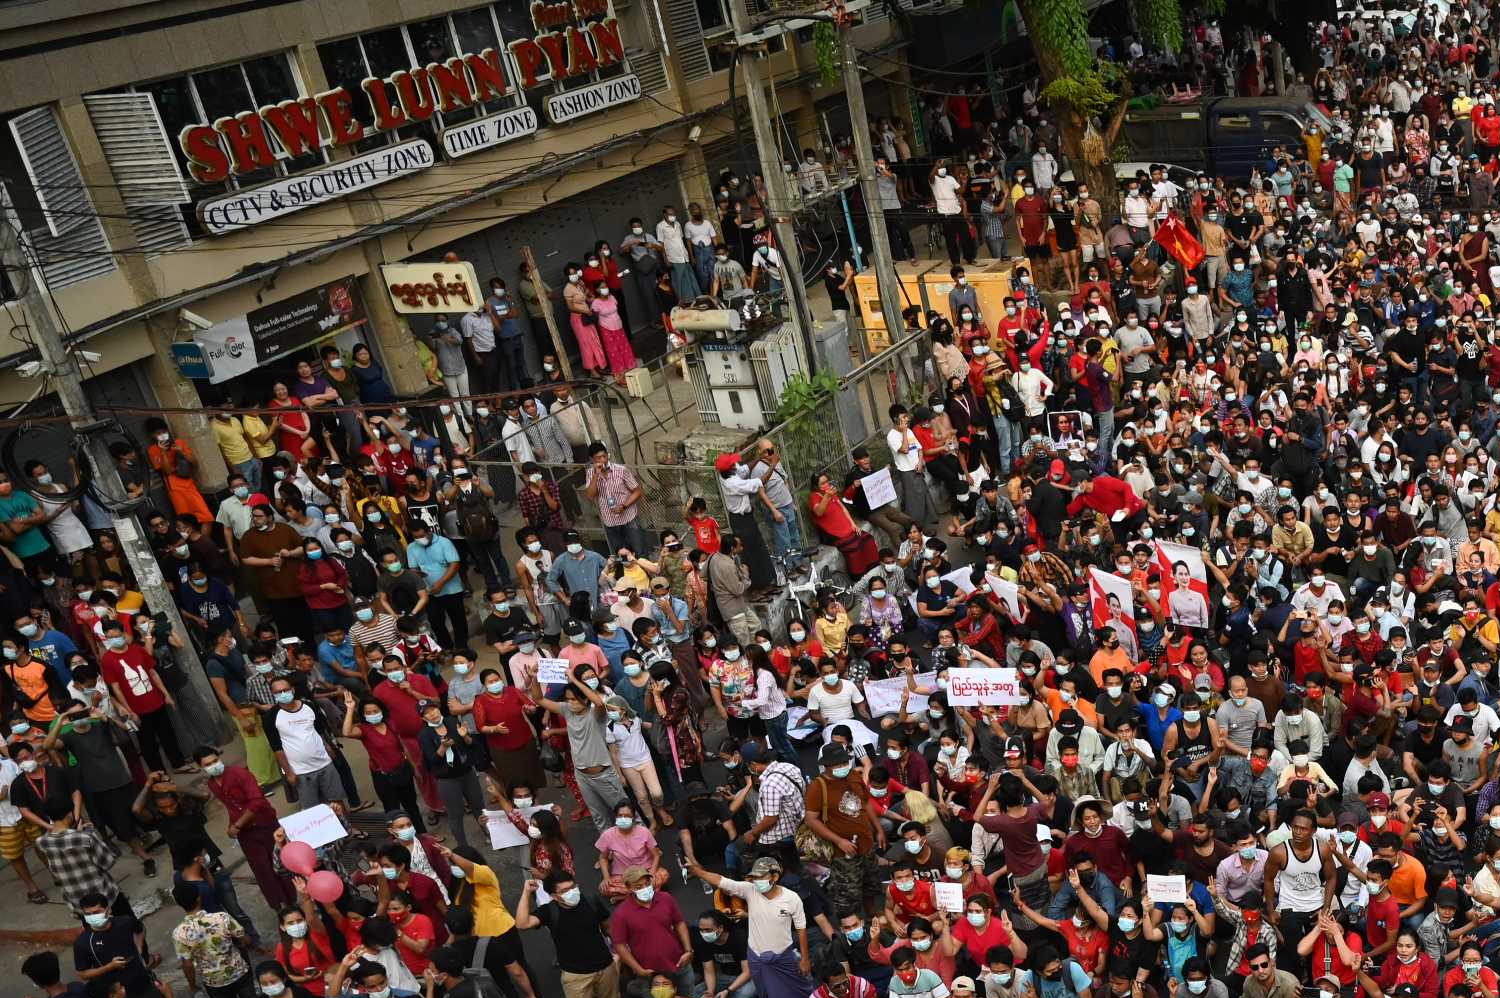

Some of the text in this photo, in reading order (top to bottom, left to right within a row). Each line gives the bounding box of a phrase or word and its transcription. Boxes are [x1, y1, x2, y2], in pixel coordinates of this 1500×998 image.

[179, 18, 625, 183] SHWE LUNN PYAN
[550, 77, 640, 120] FASHION ZONE
[446, 110, 535, 154] TIME ZONE
[209, 143, 431, 229] CCTV & SECURITY ZONE
